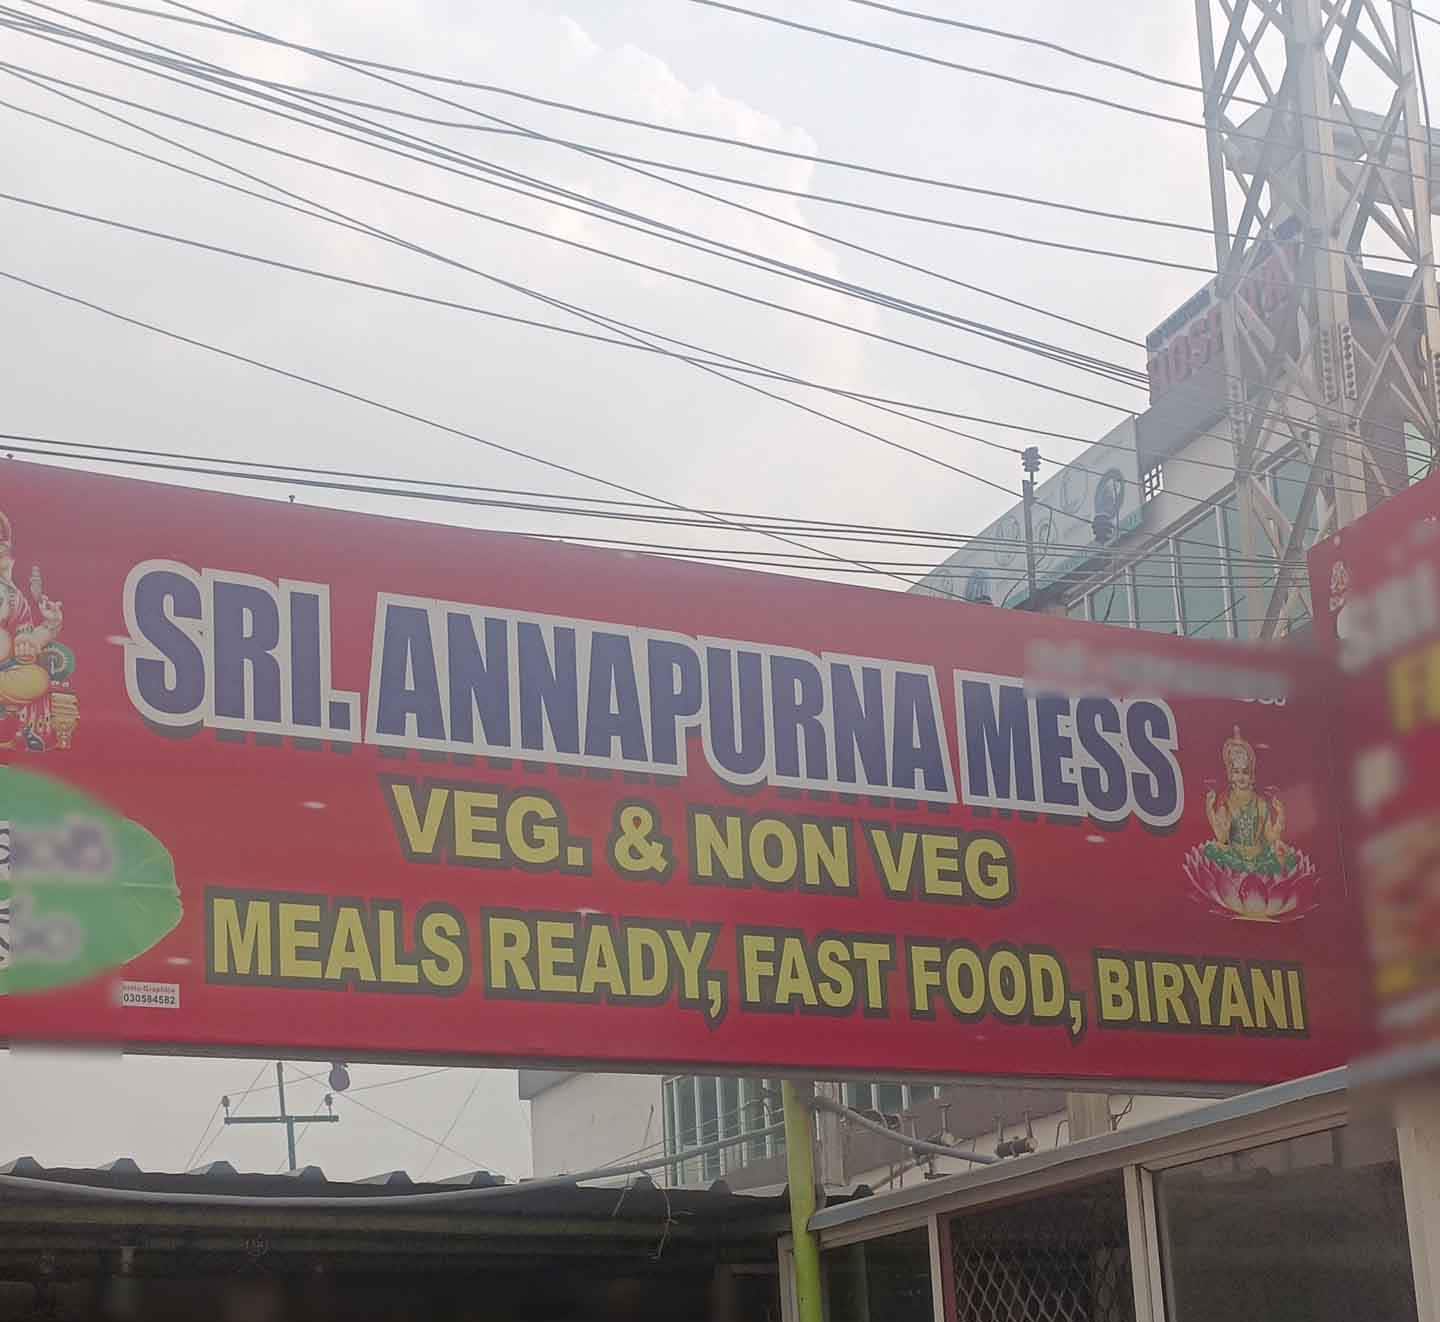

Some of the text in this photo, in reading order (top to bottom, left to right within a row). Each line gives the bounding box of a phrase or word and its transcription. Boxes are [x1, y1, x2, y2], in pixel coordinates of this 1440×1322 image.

[124, 559, 362, 744] SRI.
[364, 592, 956, 804] ANNAPURNA
[956, 669, 1185, 825] MESS
[391, 784, 1010, 900] VEG. & NON VEG
[211, 898, 1305, 1034] MEALS READY, FAST FOOD, BIRYANI
